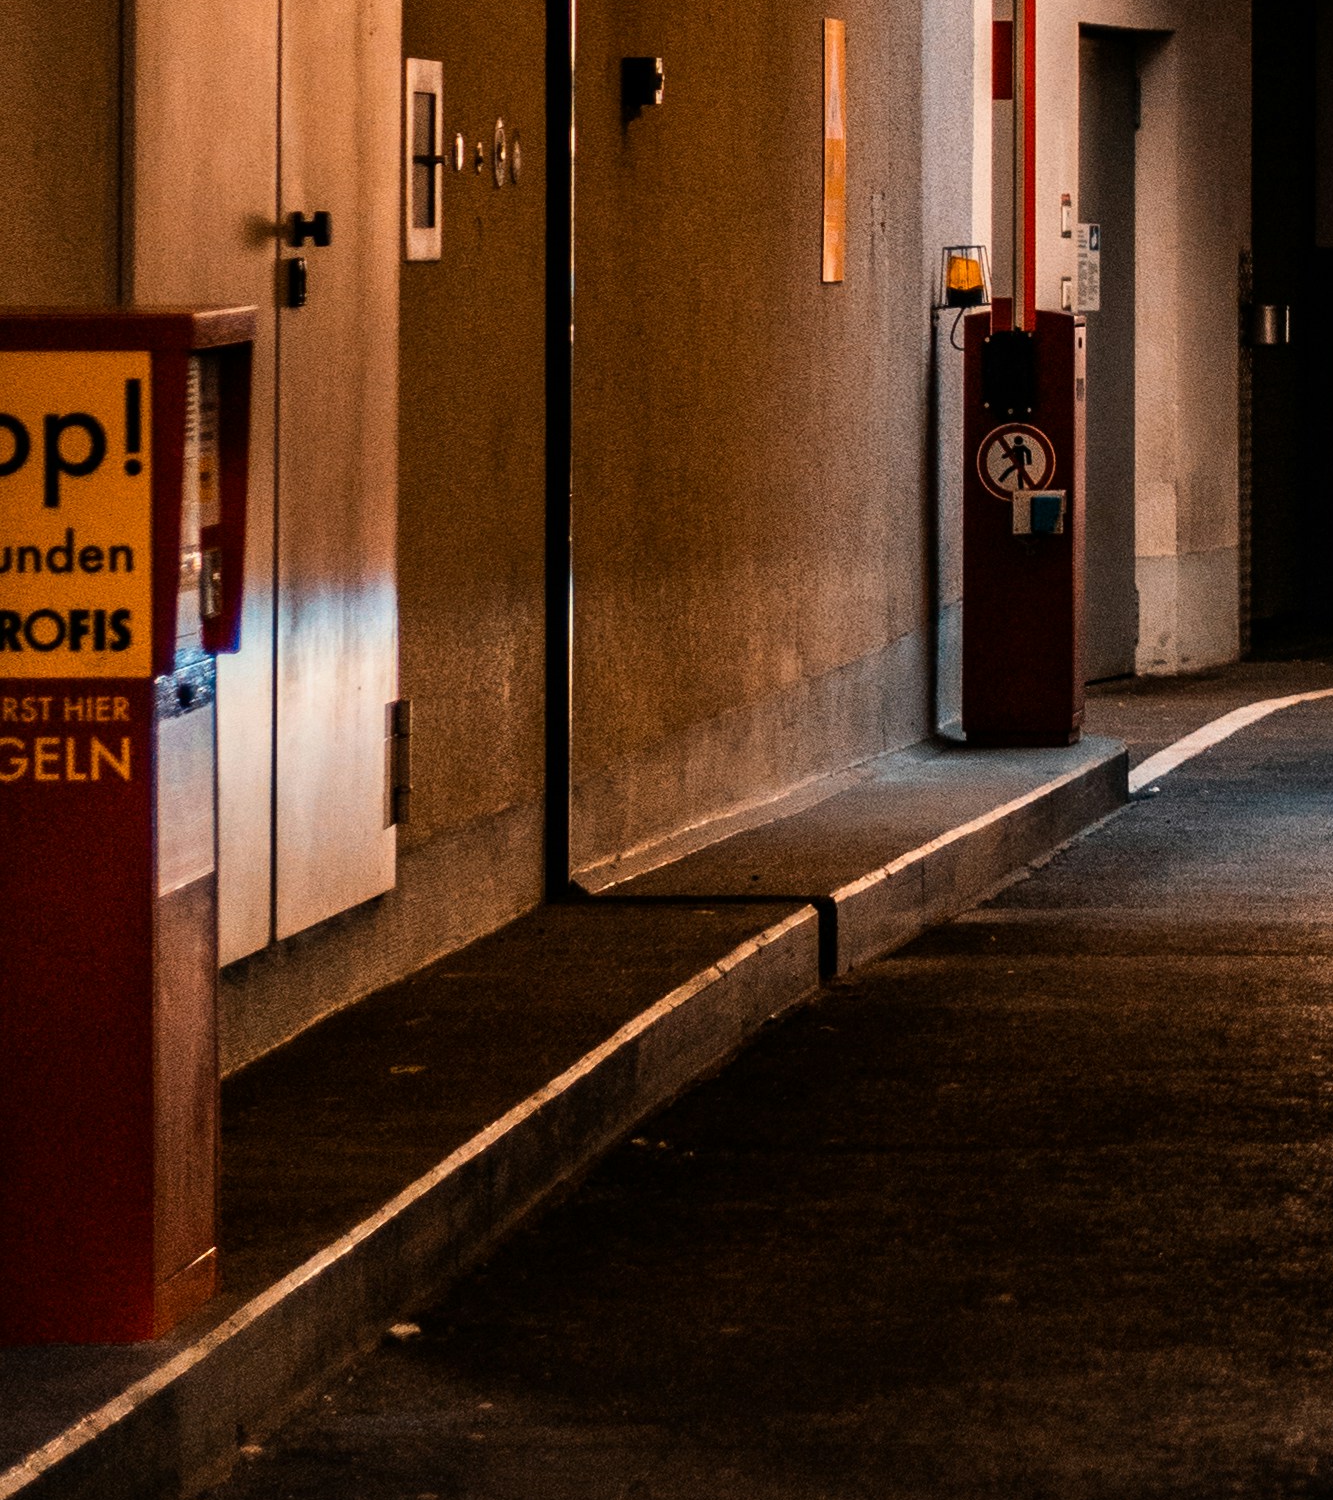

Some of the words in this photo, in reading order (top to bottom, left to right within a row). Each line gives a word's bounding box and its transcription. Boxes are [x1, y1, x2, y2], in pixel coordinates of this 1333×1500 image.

[0, 609, 132, 652] ROFIS
[64, 697, 130, 721] HIER
[0, 737, 131, 781] GELN
